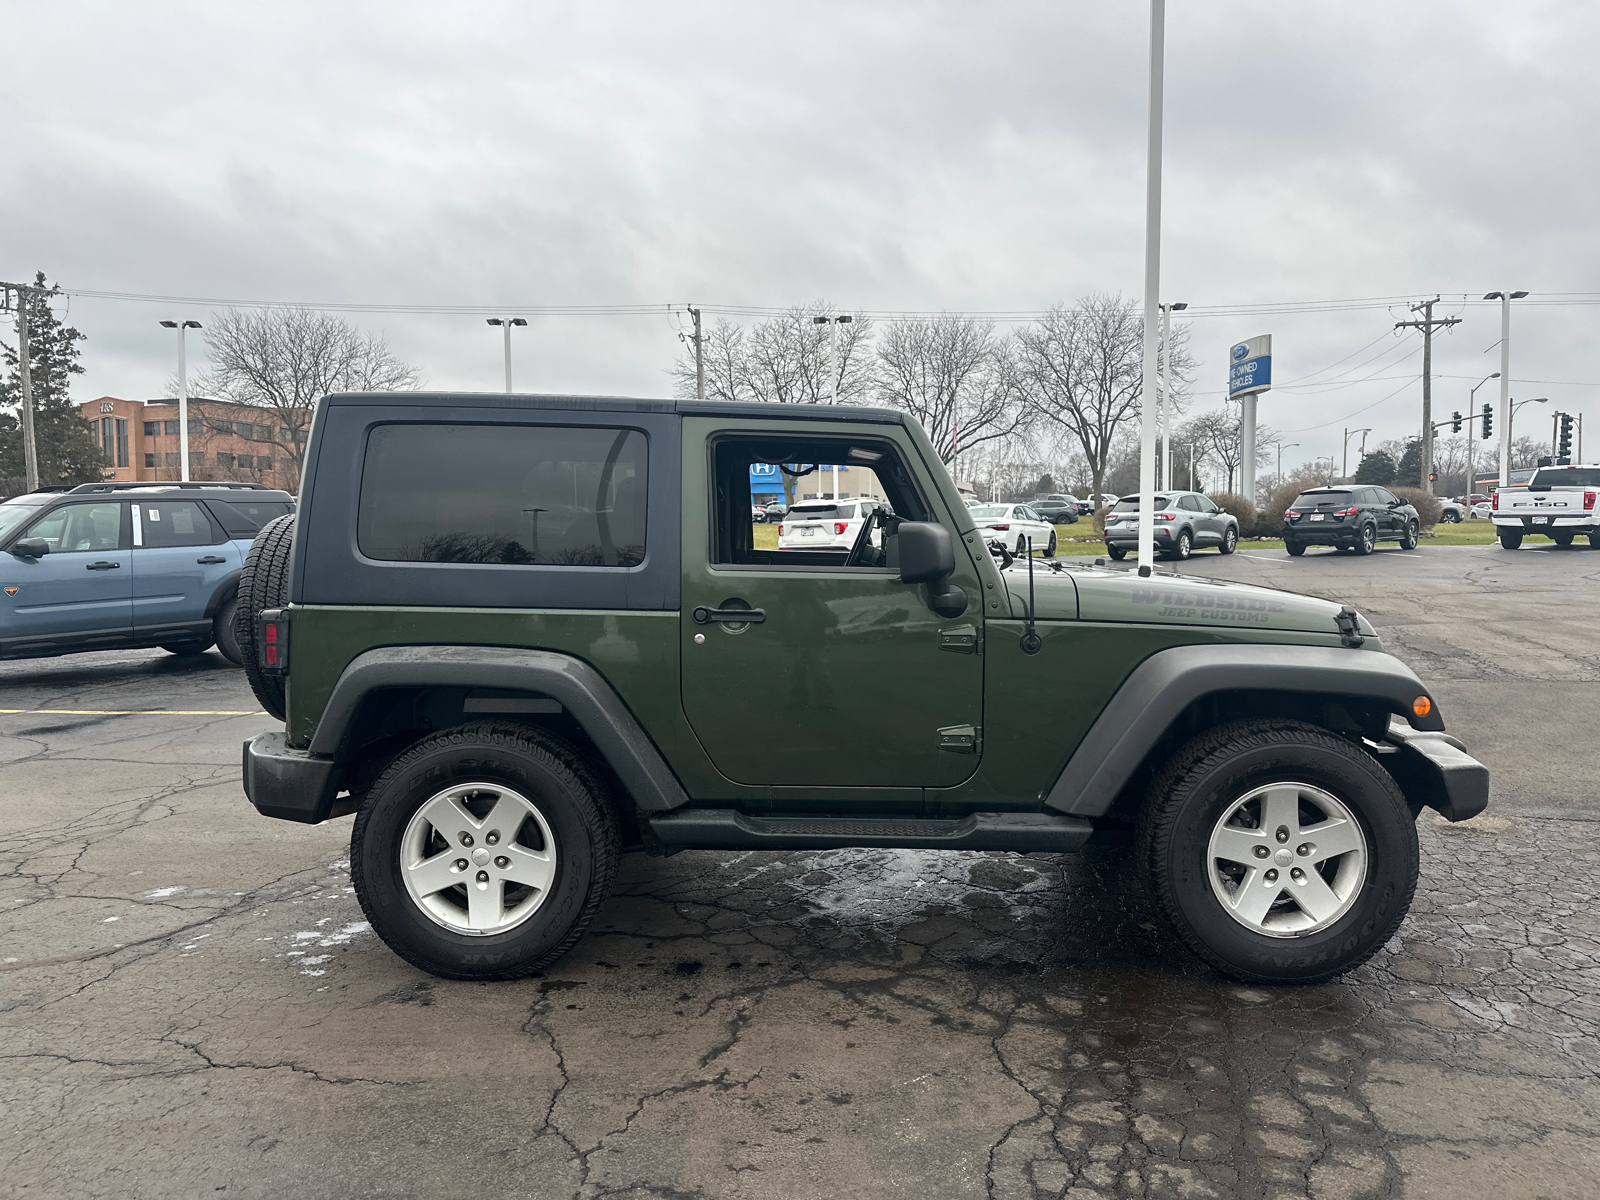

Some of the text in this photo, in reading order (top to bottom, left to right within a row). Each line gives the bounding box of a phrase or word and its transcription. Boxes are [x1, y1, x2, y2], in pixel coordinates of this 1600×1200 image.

[1230, 361, 1258, 378] RE-OWNED
[1131, 589, 1285, 613] WILDSIDE
[1158, 606, 1269, 623] JEEP CUSTOMS
